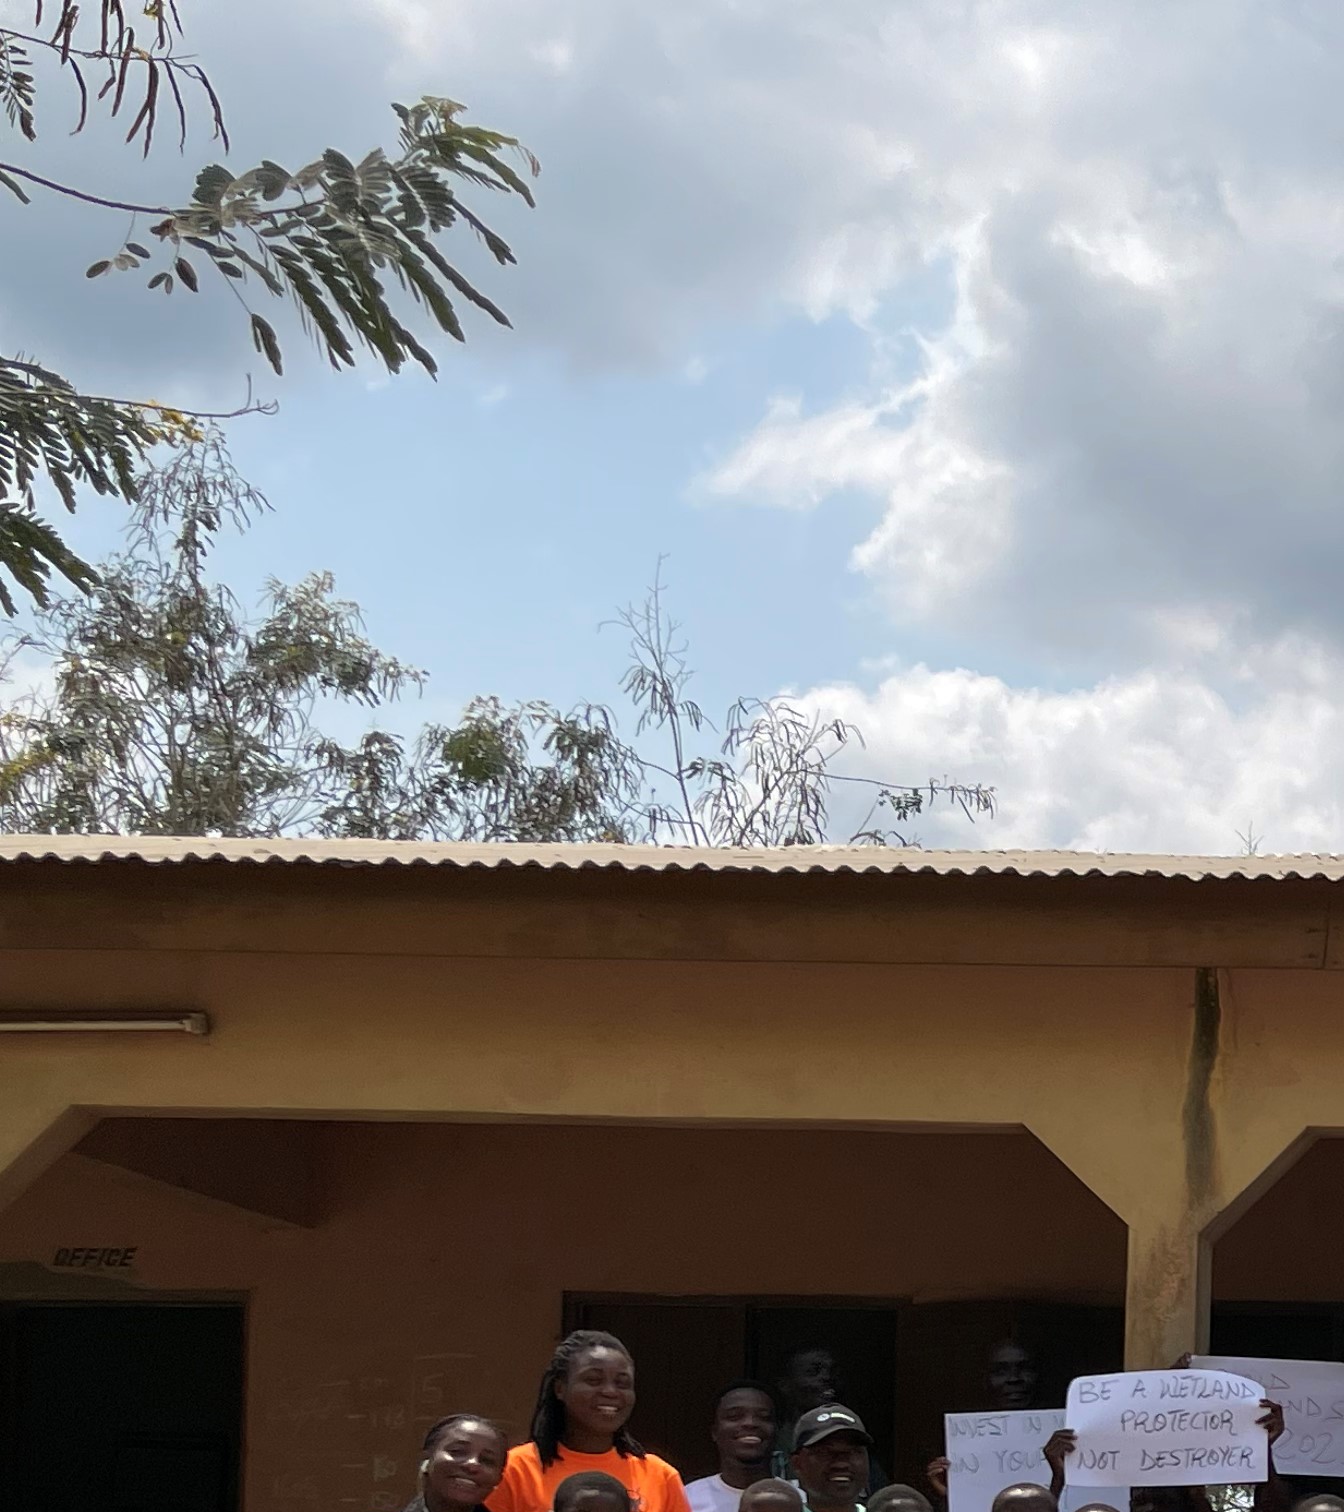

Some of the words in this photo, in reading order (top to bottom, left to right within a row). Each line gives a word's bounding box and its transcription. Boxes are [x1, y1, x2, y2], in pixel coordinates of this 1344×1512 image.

[53, 1246, 138, 1267] OFFICE
[1079, 1380, 1119, 1404] BE
[1133, 1379, 1147, 1399] A
[1160, 1374, 1255, 1399] WETLAND
[1120, 1408, 1237, 1436] PROTECTOR
[1077, 1449, 1120, 1471] NOT
[1140, 1445, 1255, 1471] DESTROYER
